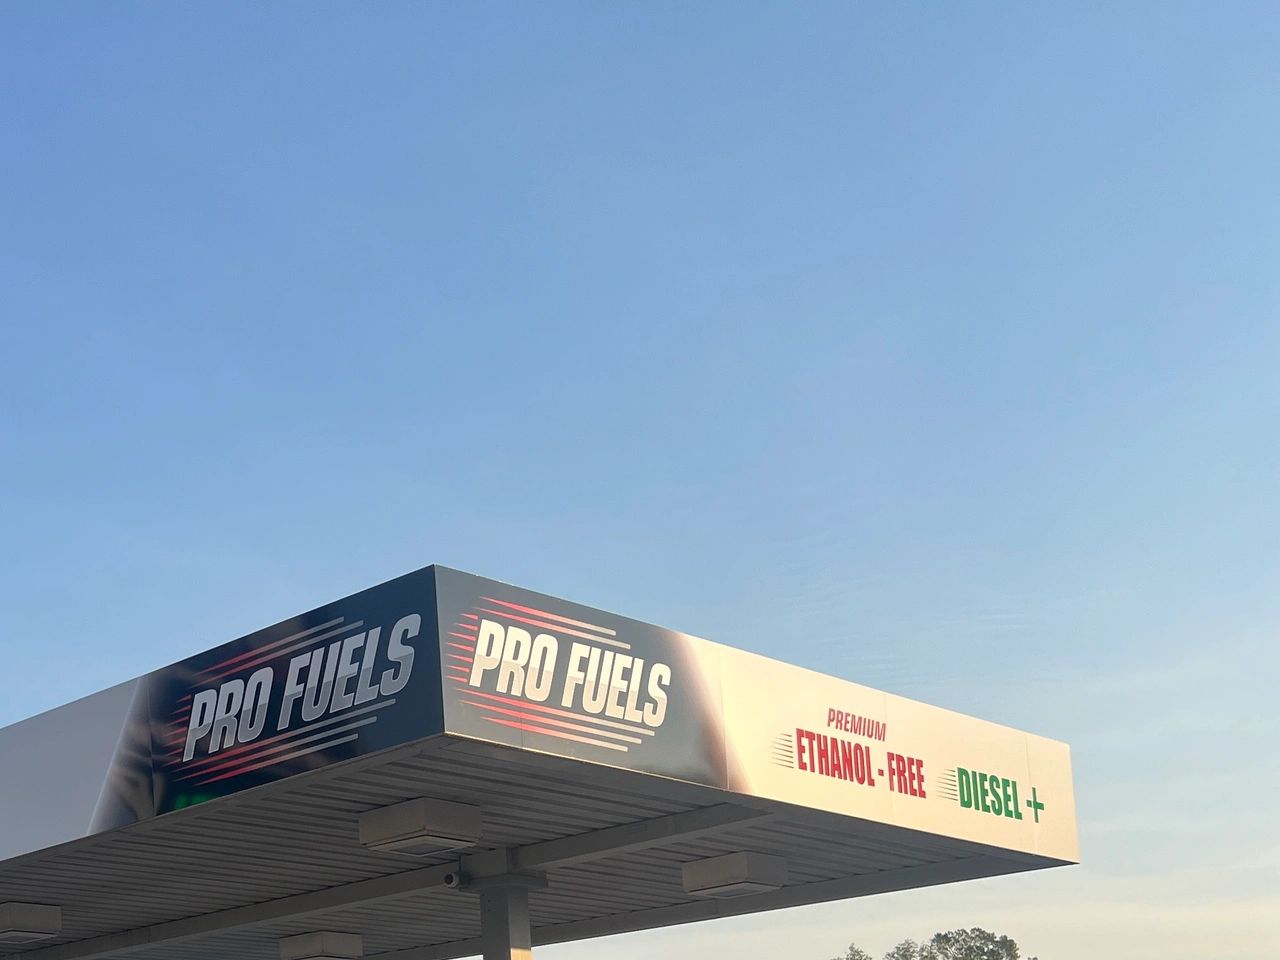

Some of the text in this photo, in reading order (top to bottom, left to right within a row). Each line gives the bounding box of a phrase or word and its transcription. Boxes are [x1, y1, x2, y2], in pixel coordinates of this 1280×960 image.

[183, 613, 423, 762] PRO FUELS
[468, 617, 671, 729] PRO FUELS
[827, 707, 887, 742] PREMIUM
[956, 767, 1023, 822] DIESEL
